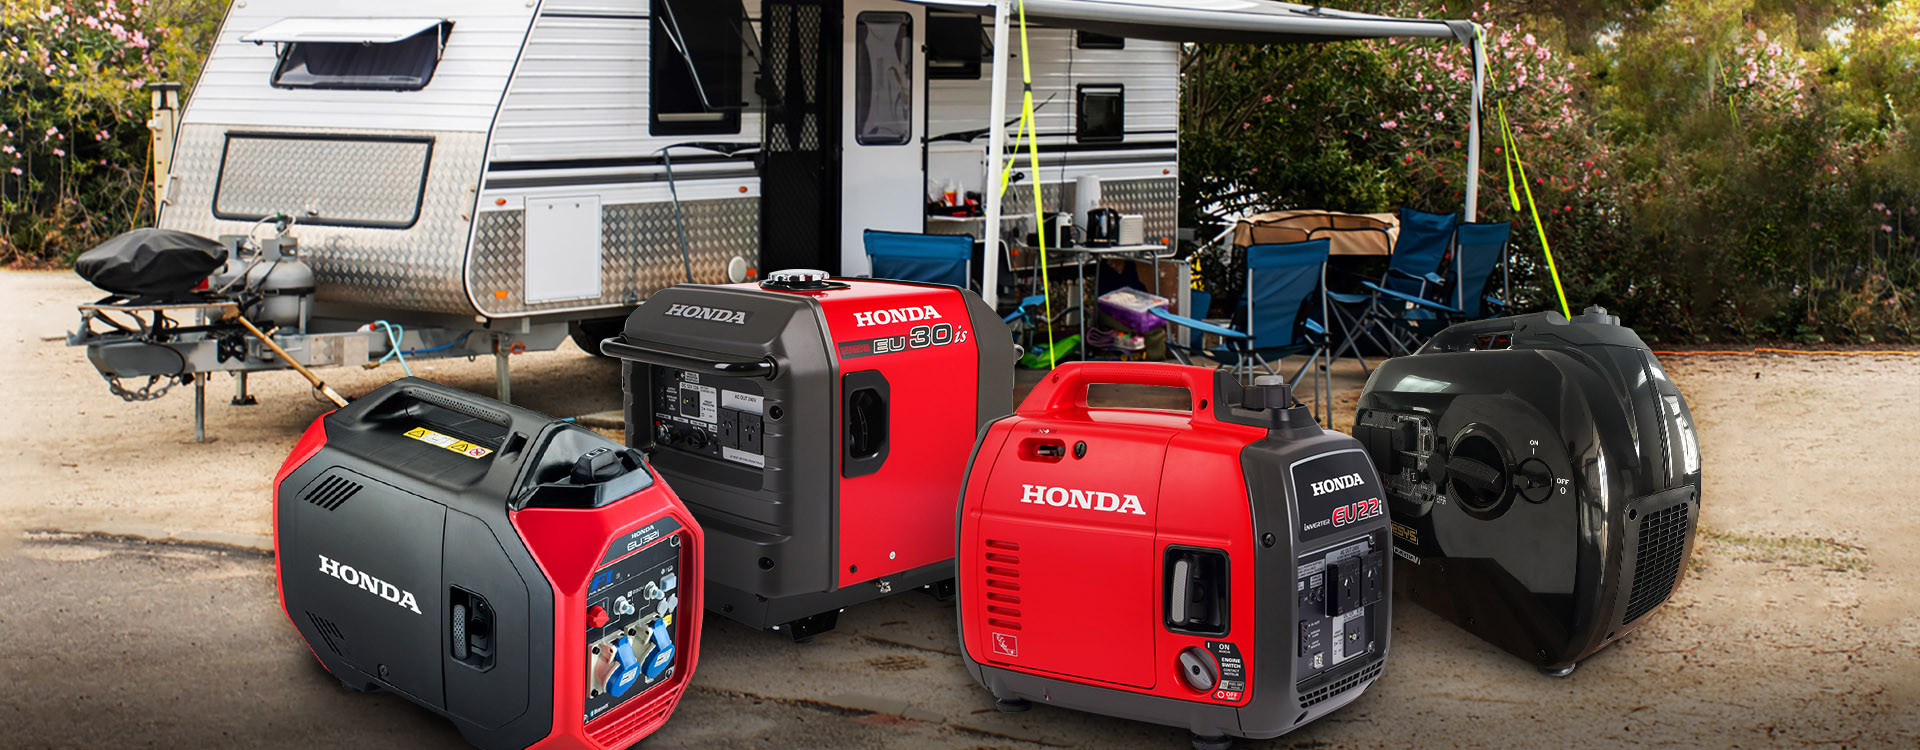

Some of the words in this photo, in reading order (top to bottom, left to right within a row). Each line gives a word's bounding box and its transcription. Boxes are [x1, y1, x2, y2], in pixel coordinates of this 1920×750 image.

[665, 304, 746, 324] HONDA
[853, 305, 942, 327] HONDA
[1311, 473, 1365, 496] HONDA
[1020, 484, 1146, 515] HONDA
[1332, 498, 1384, 527] EU22i
[631, 525, 655, 539] HONDA
[319, 554, 422, 615] HONDA
